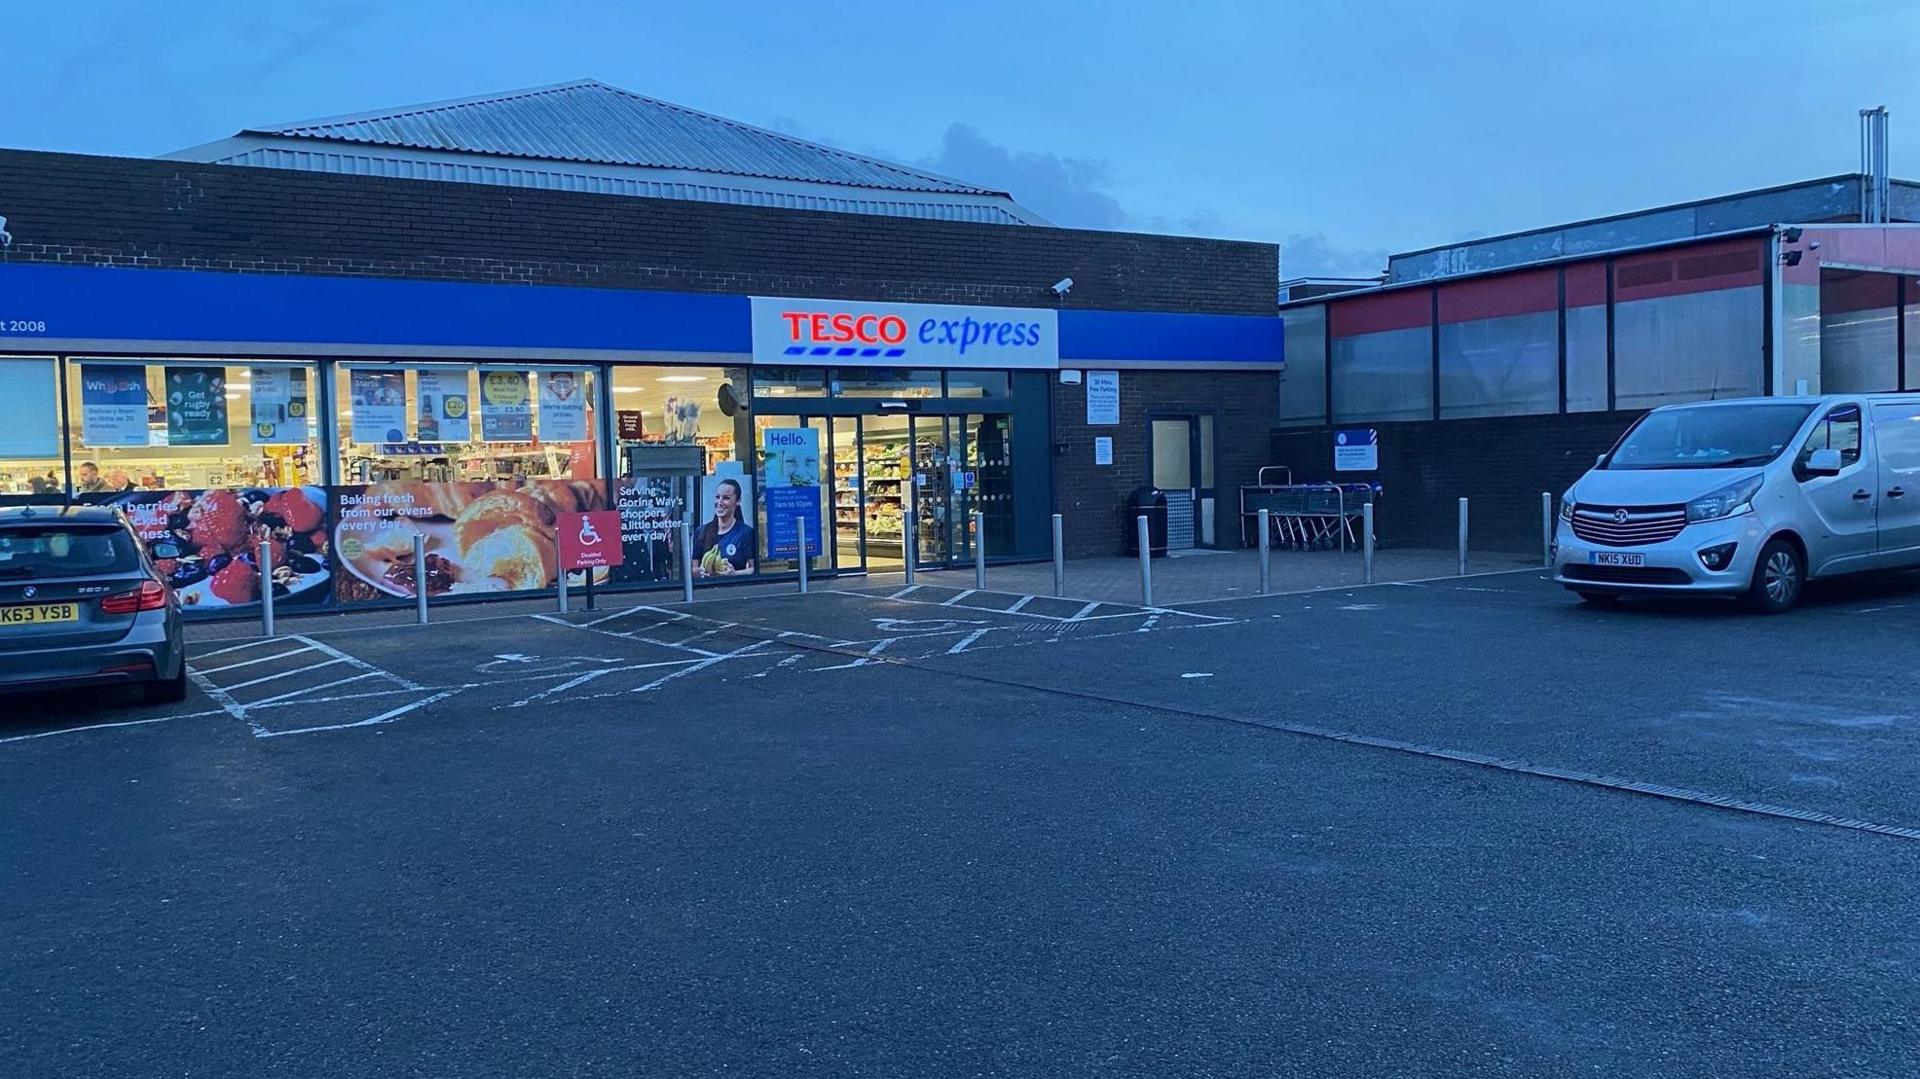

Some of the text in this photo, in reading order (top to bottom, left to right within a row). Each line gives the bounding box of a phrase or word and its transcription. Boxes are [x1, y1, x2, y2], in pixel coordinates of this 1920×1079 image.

[10, 320, 46, 332] 2008
[782, 312, 1040, 354] TESCO express
[188, 391, 206, 399] Get
[184, 400, 211, 412] rugby
[184, 410, 211, 420] ready
[770, 433, 807, 446] Hello.
[620, 487, 656, 497] Serving
[340, 493, 415, 506] Baking fresh
[620, 496, 684, 508] Goring Way's
[127, 501, 178, 513] berries
[340, 507, 433, 518] from our ovens
[621, 509, 666, 521] shoppers
[341, 521, 377, 532] every
[628, 520, 650, 530] little
[652, 519, 682, 529] better
[621, 531, 667, 543] every day
[39, 605, 71, 620] YSB
